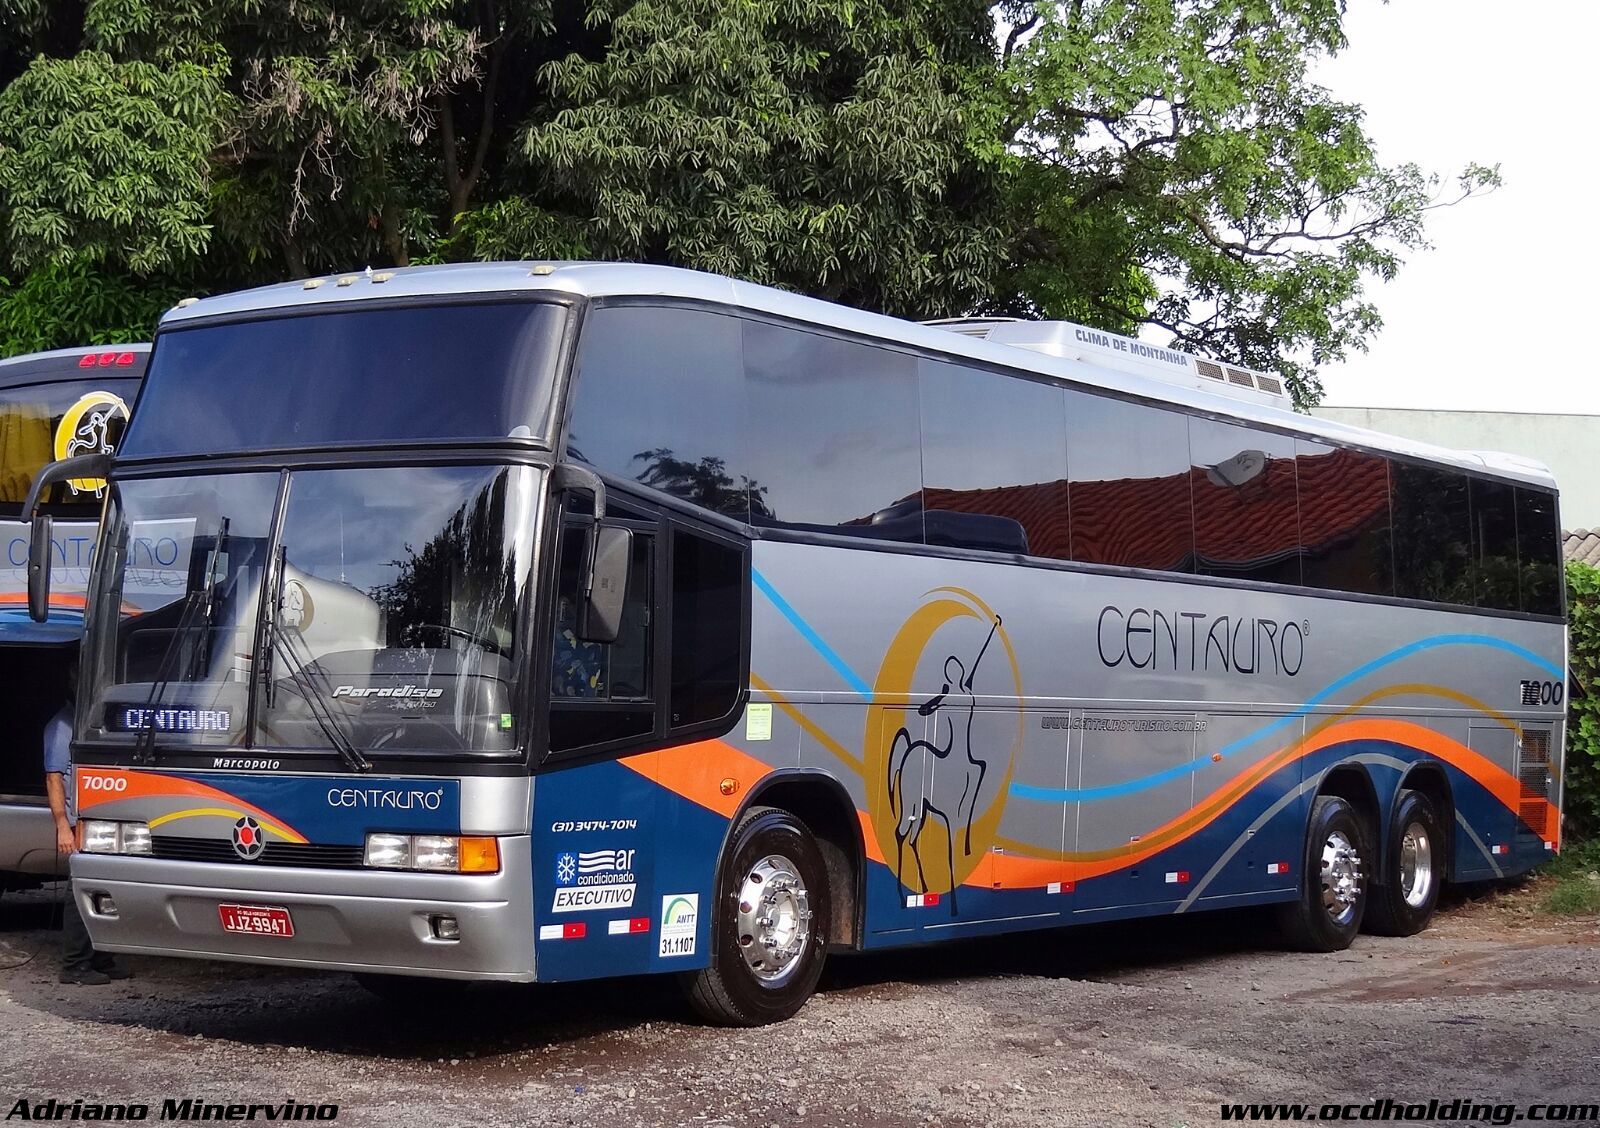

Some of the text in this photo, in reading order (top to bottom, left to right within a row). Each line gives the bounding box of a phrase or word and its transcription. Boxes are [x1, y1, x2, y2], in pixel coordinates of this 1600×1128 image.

[1075, 329, 1188, 367] CLIMA DE MONTANHA
[332, 685, 444, 698] Paradiso
[126, 709, 231, 731] CENTAURO
[213, 758, 280, 770] Marcopolo
[82, 775, 128, 792] 7000
[575, 819, 637, 831] 3474-7014
[615, 849, 635, 870] ar
[577, 870, 634, 886] condicionado
[556, 888, 633, 907] EXECUTIVO
[676, 914, 695, 923] ANTT
[661, 936, 694, 954] 31.1107
